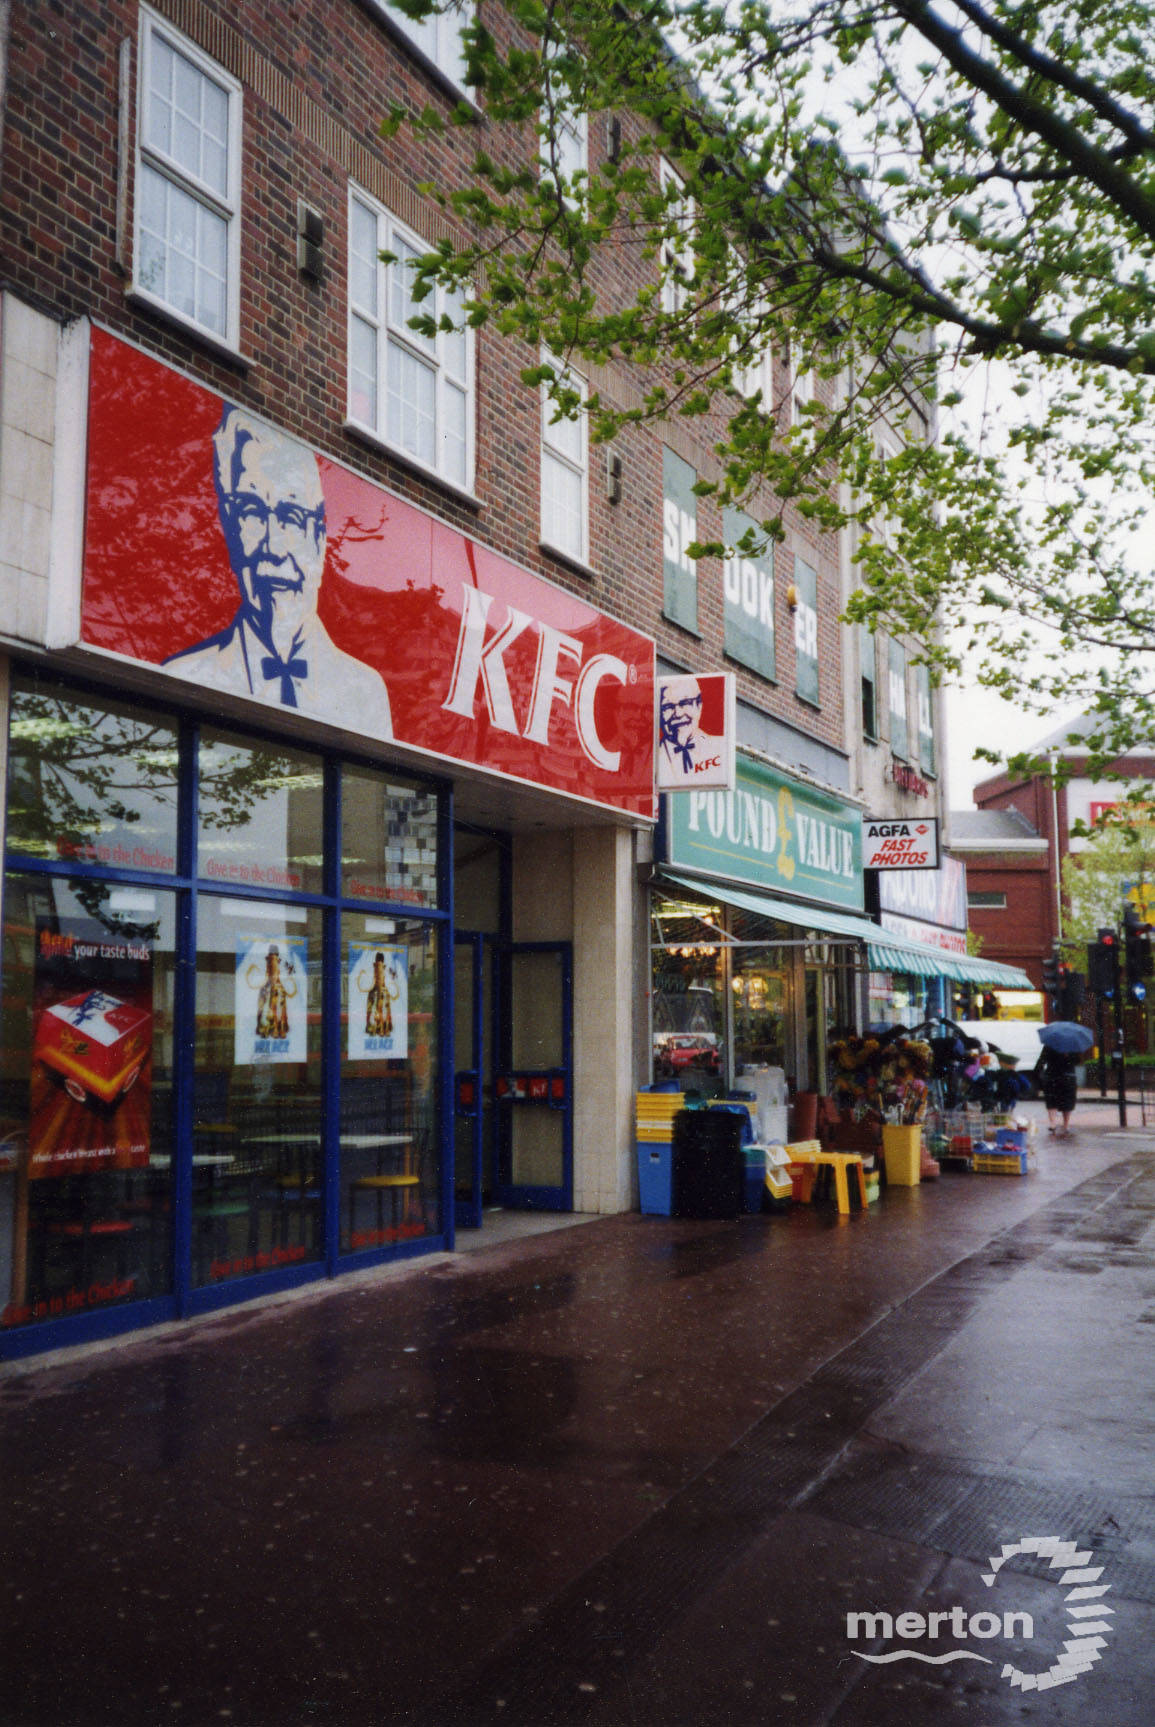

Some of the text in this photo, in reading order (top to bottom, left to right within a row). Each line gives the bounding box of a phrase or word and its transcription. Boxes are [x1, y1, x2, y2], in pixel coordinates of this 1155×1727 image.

[441, 582, 628, 772] KFC
[694, 755, 722, 774] KFC
[688, 790, 777, 854] POUND
[796, 812, 855, 879] VALUE
[868, 824, 911, 838] AGFA
[880, 838, 917, 852] FAST
[133, 846, 175, 870] Chicken
[870, 851, 929, 866] PHOTOS
[74, 942, 150, 961] your taste buds
